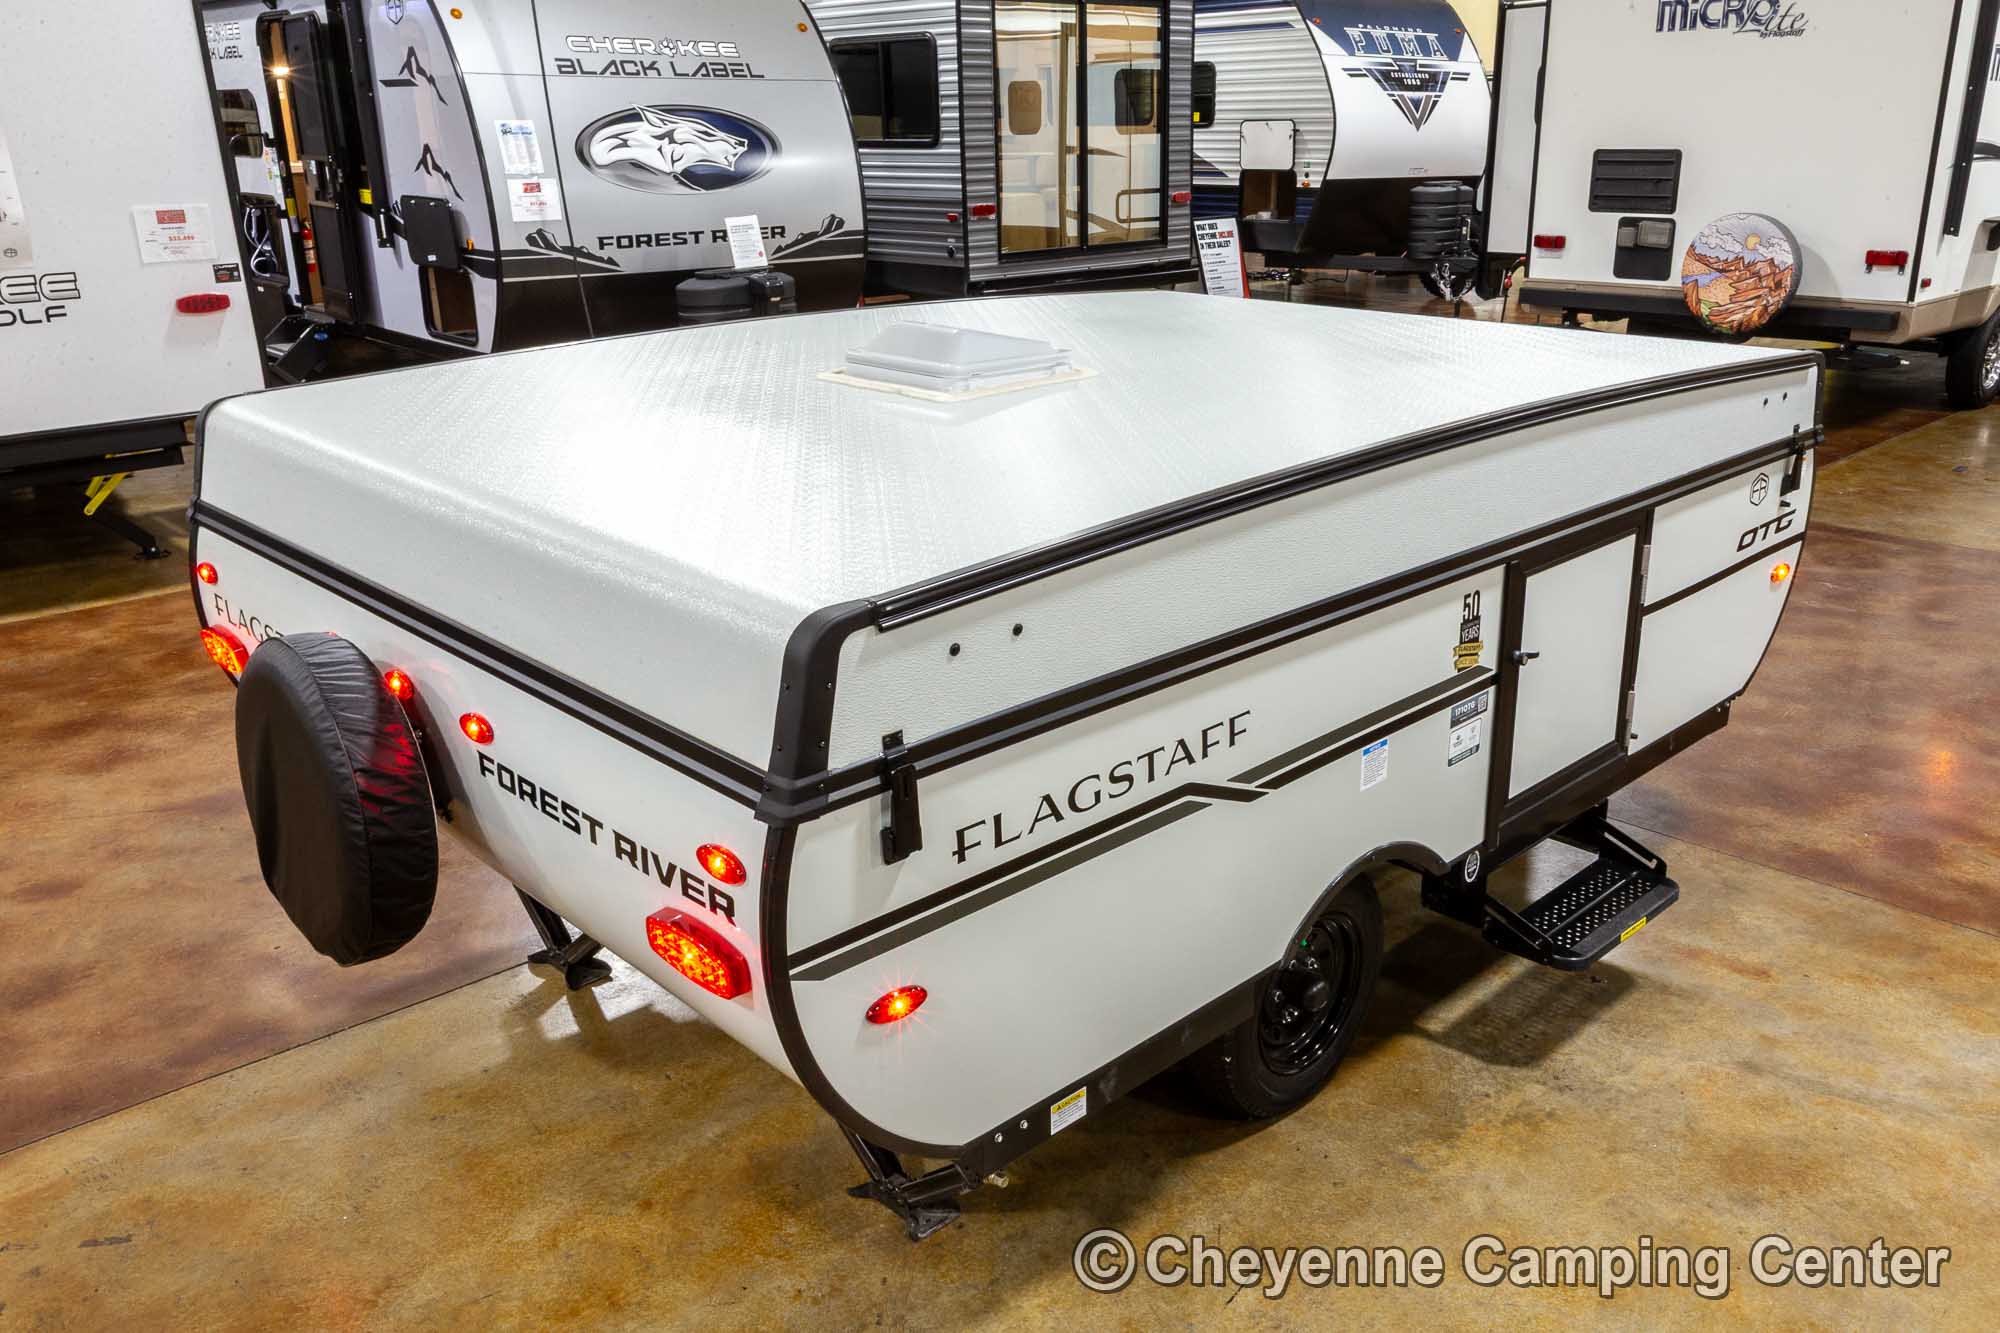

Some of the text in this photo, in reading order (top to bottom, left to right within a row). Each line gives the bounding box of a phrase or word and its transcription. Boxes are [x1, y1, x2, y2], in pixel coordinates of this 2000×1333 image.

[1344, 29, 1449, 60] PUMA
[554, 57, 766, 79] BLACK LABEL
[596, 230, 705, 251] FOREST
[710, 225, 787, 244] RER
[1736, 508, 1797, 553] OTG
[1462, 589, 1481, 620] 50
[1461, 624, 1480, 643] YEARS
[952, 709, 1251, 865] FLAGSTAFF
[476, 750, 737, 928] FOREST RIVER
